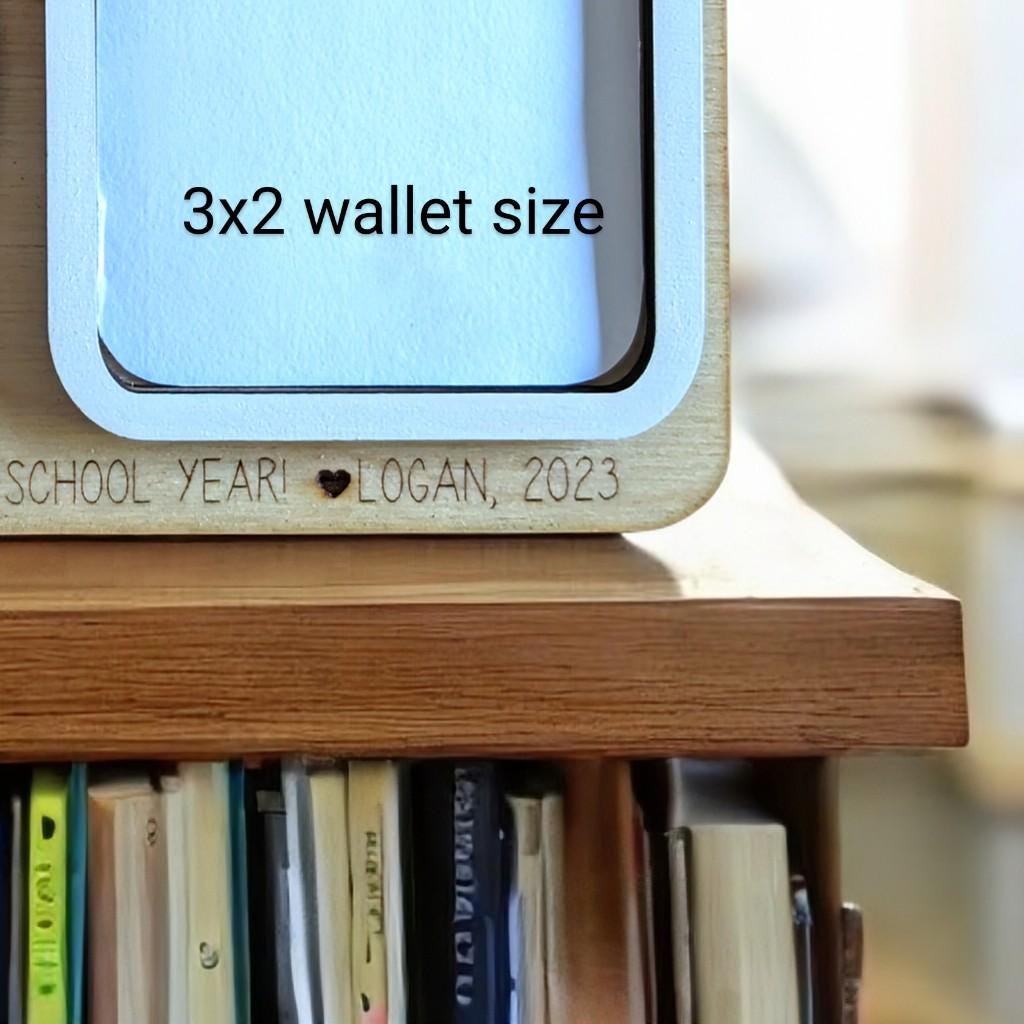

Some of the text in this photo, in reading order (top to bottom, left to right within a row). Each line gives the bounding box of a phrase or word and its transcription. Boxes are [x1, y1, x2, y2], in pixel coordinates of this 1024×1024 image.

[4, 459, 151, 507] SCHOOL
[357, 457, 498, 509] LOGAN,
[524, 456, 620, 503] 2023
